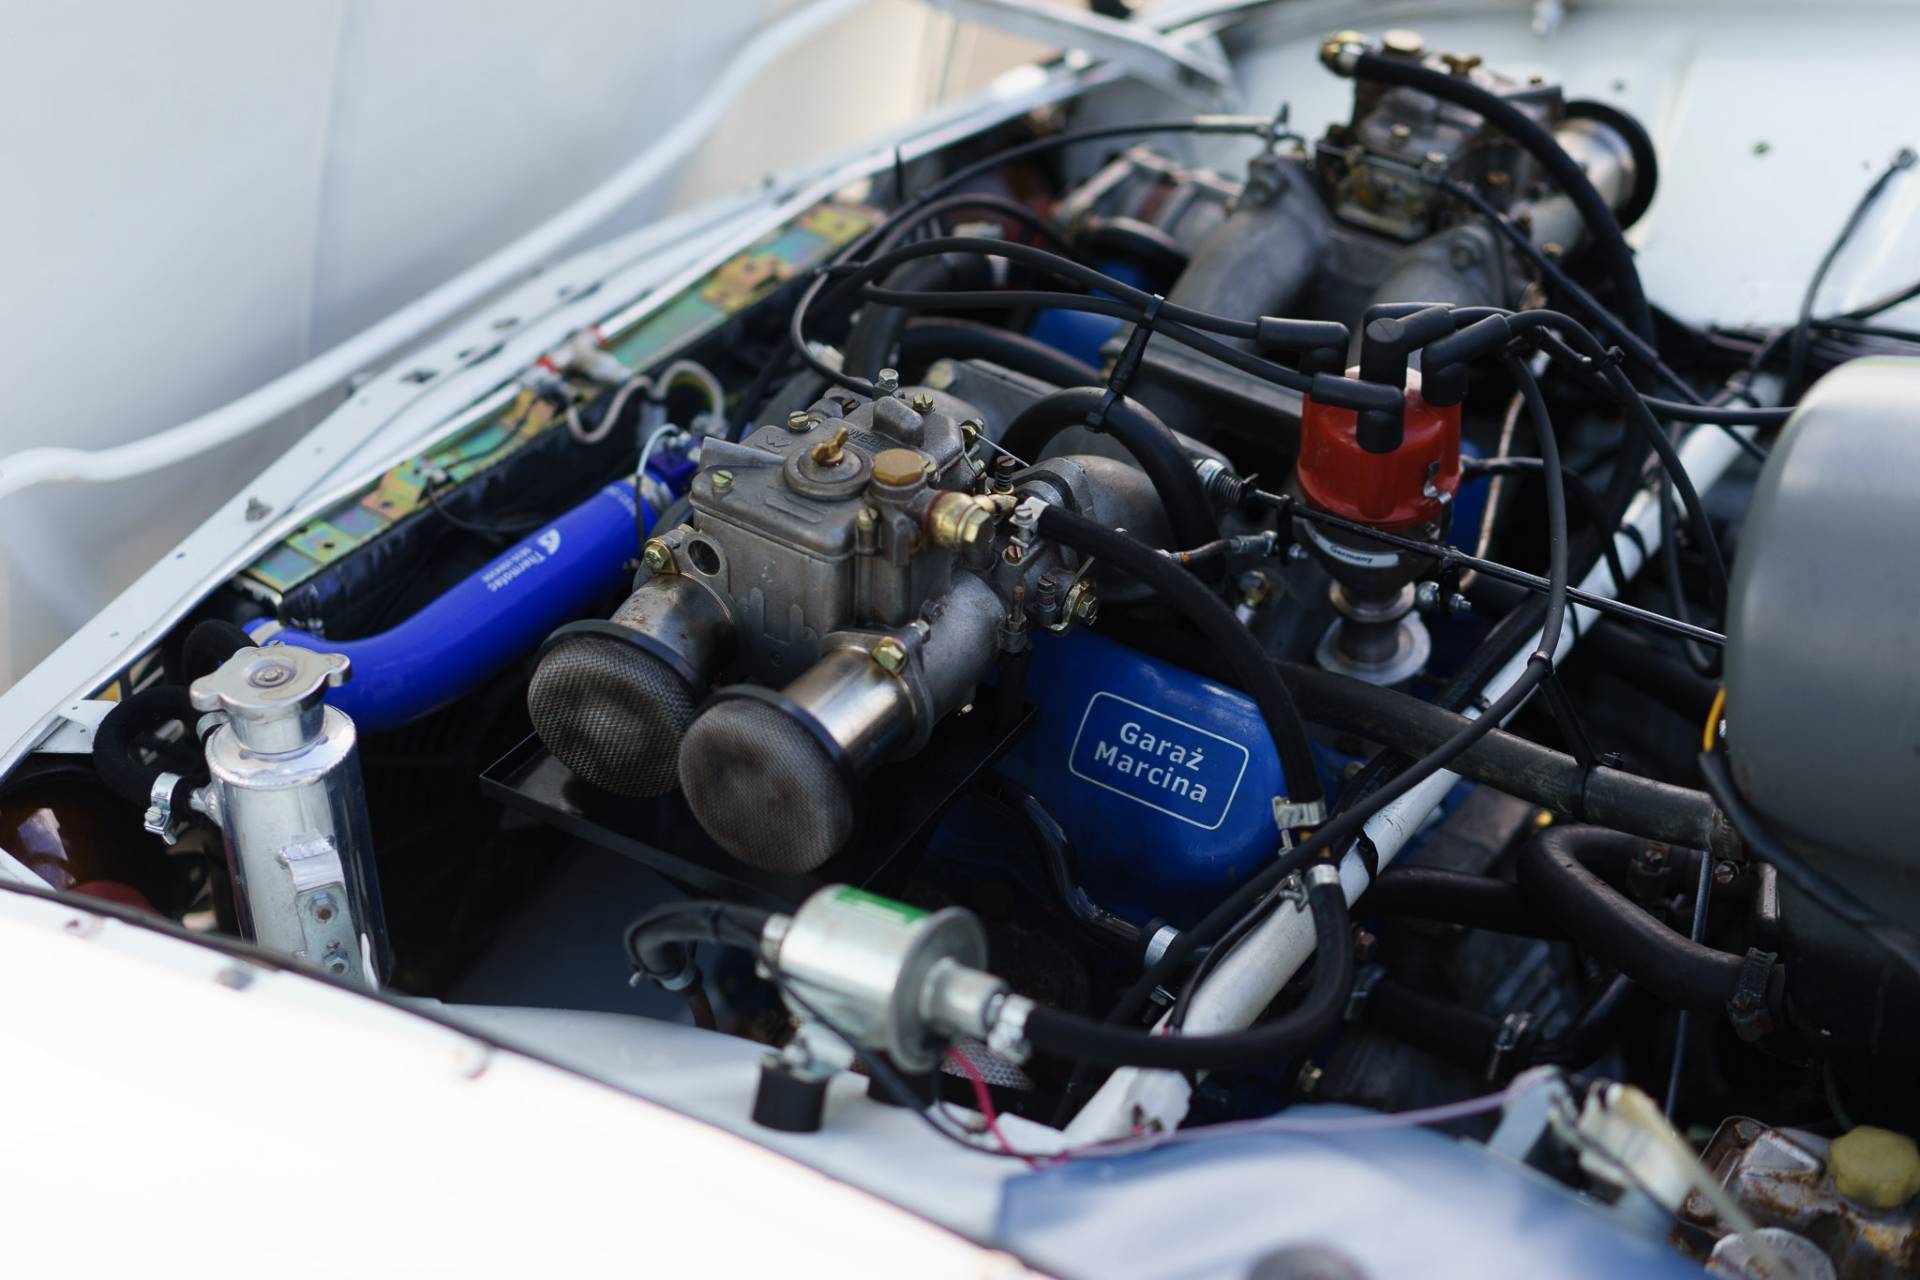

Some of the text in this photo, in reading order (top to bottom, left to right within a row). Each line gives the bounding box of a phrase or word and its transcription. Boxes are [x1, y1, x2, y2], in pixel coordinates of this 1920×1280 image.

[1329, 544, 1374, 564] Germany
[1119, 721, 1205, 771] Garaż
[1093, 740, 1208, 803] Marcina
